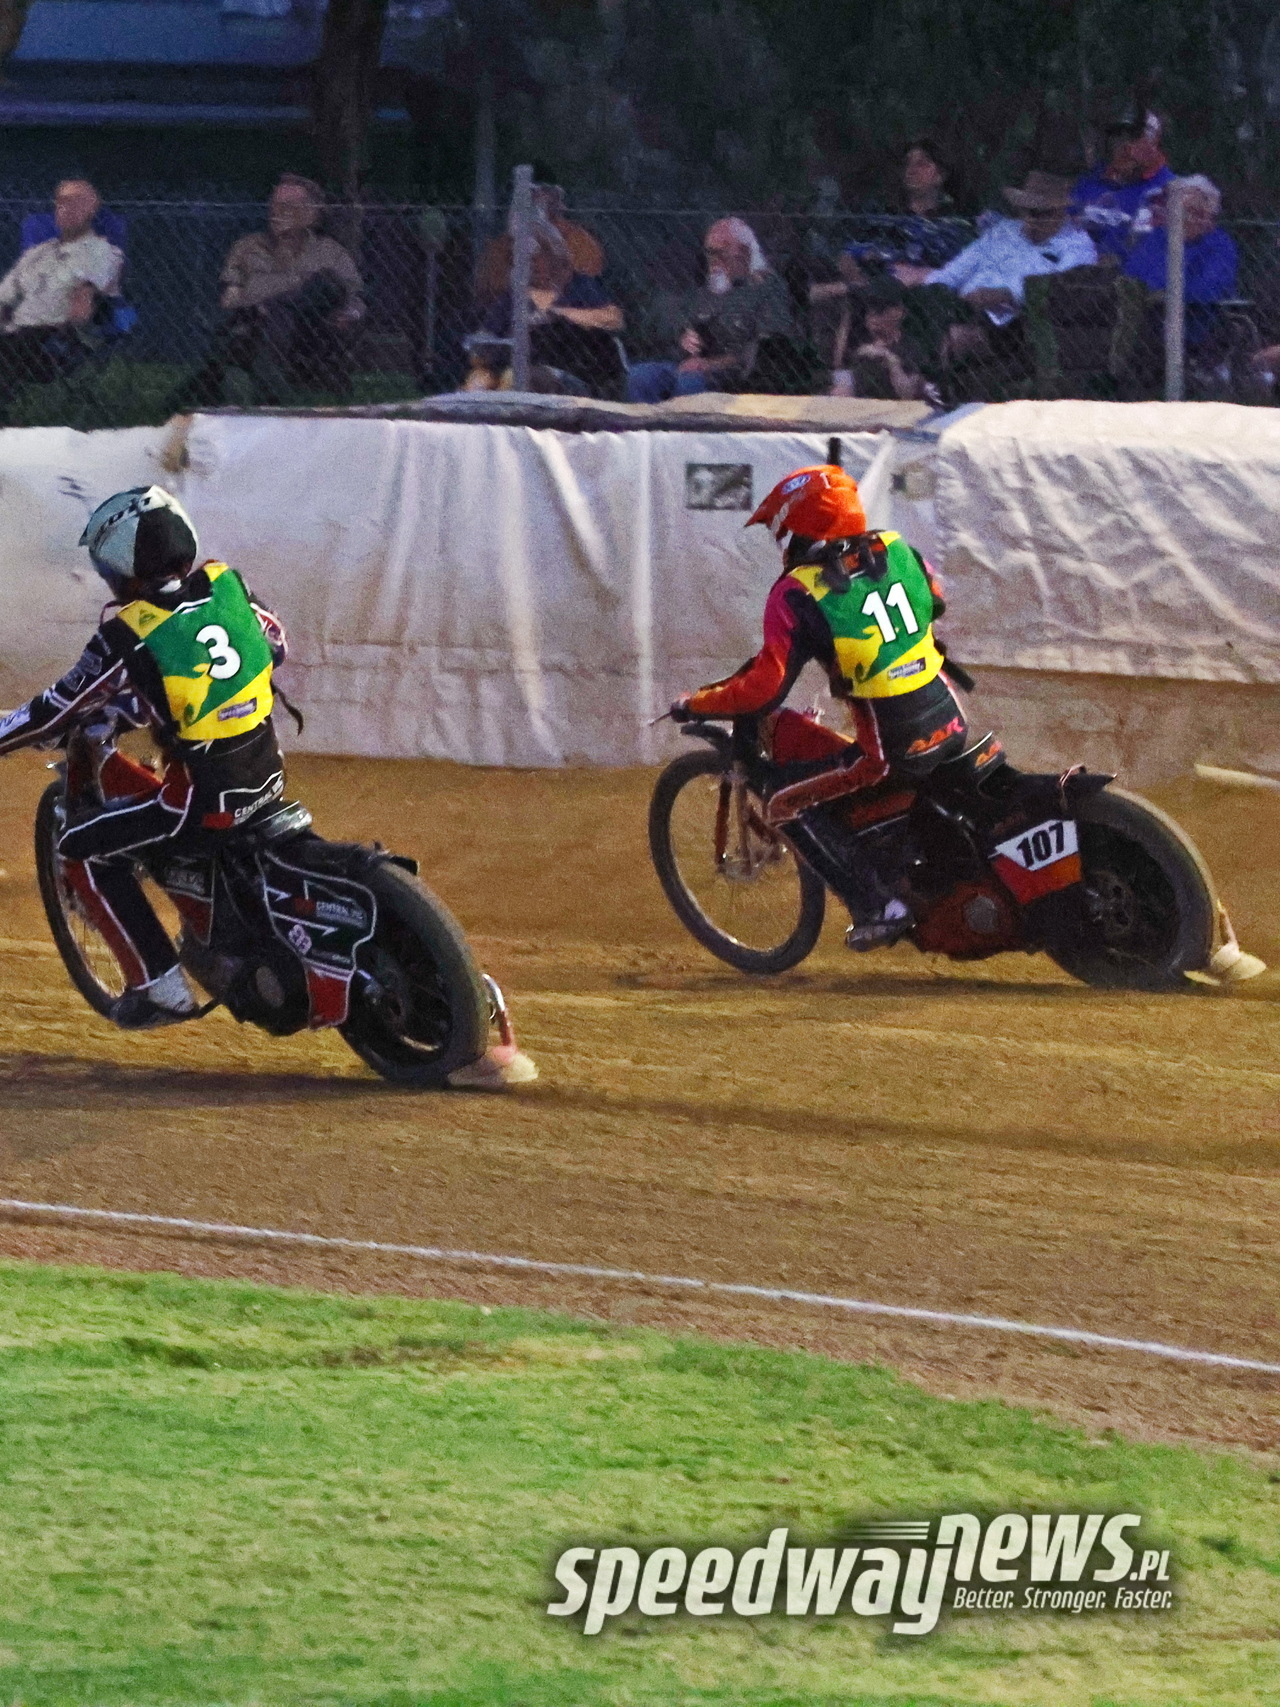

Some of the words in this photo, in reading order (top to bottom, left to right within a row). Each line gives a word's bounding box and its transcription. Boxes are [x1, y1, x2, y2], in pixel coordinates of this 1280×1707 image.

[861, 582, 919, 643] 11
[195, 624, 241, 680] 3
[1016, 822, 1064, 868] 107
